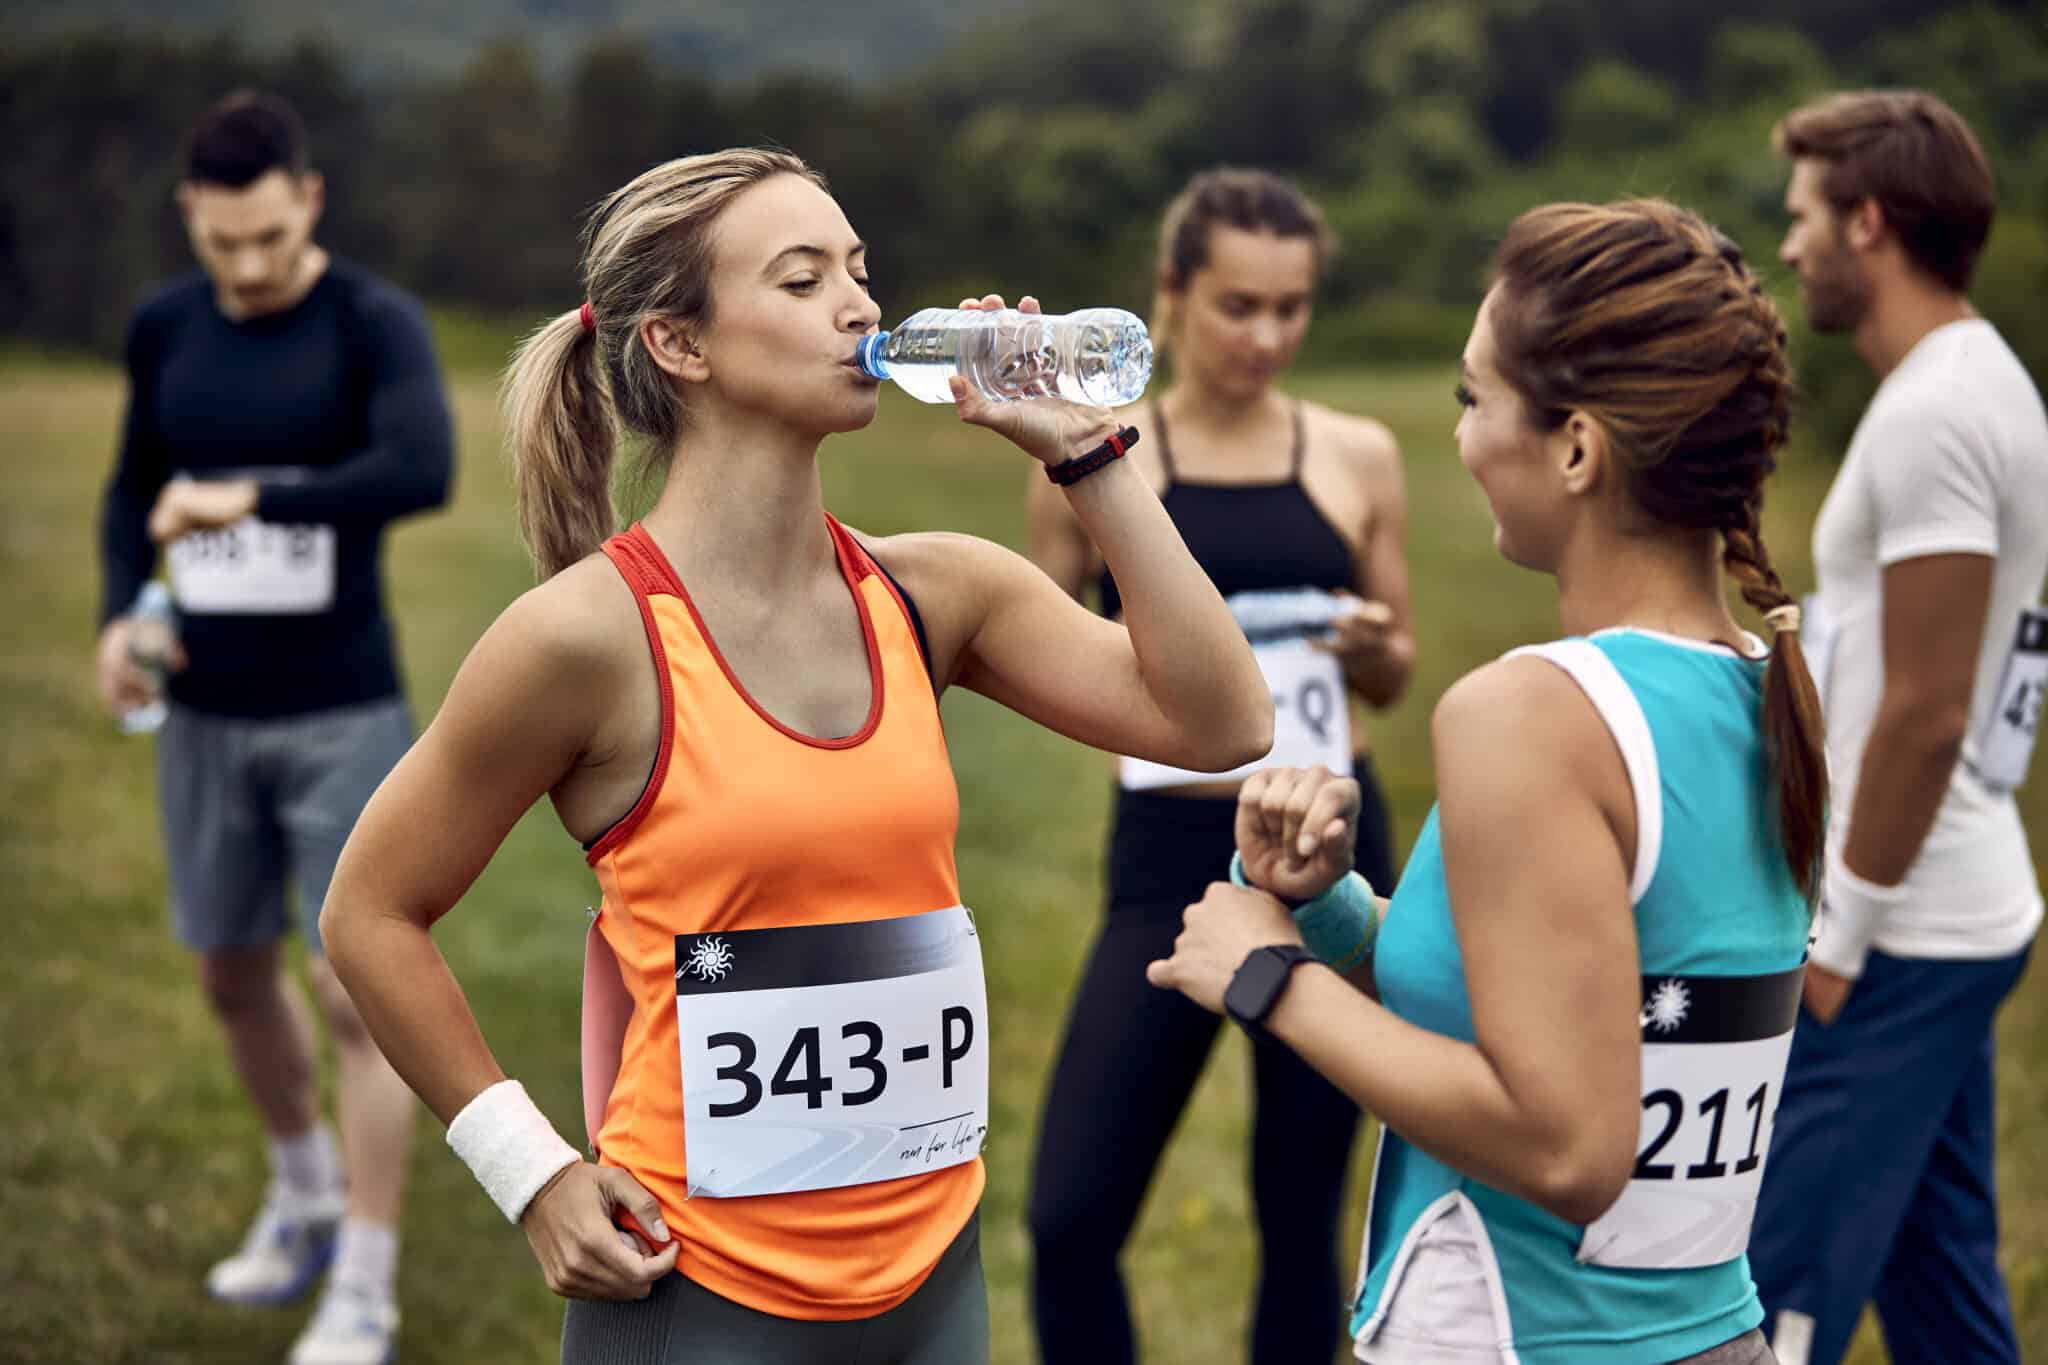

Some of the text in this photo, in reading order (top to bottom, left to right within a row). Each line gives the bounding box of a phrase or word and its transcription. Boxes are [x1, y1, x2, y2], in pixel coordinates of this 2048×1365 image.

[707, 1005, 974, 1118] 343-P
[900, 1119, 974, 1163] run for life
[1631, 1082, 1777, 1179] 211
